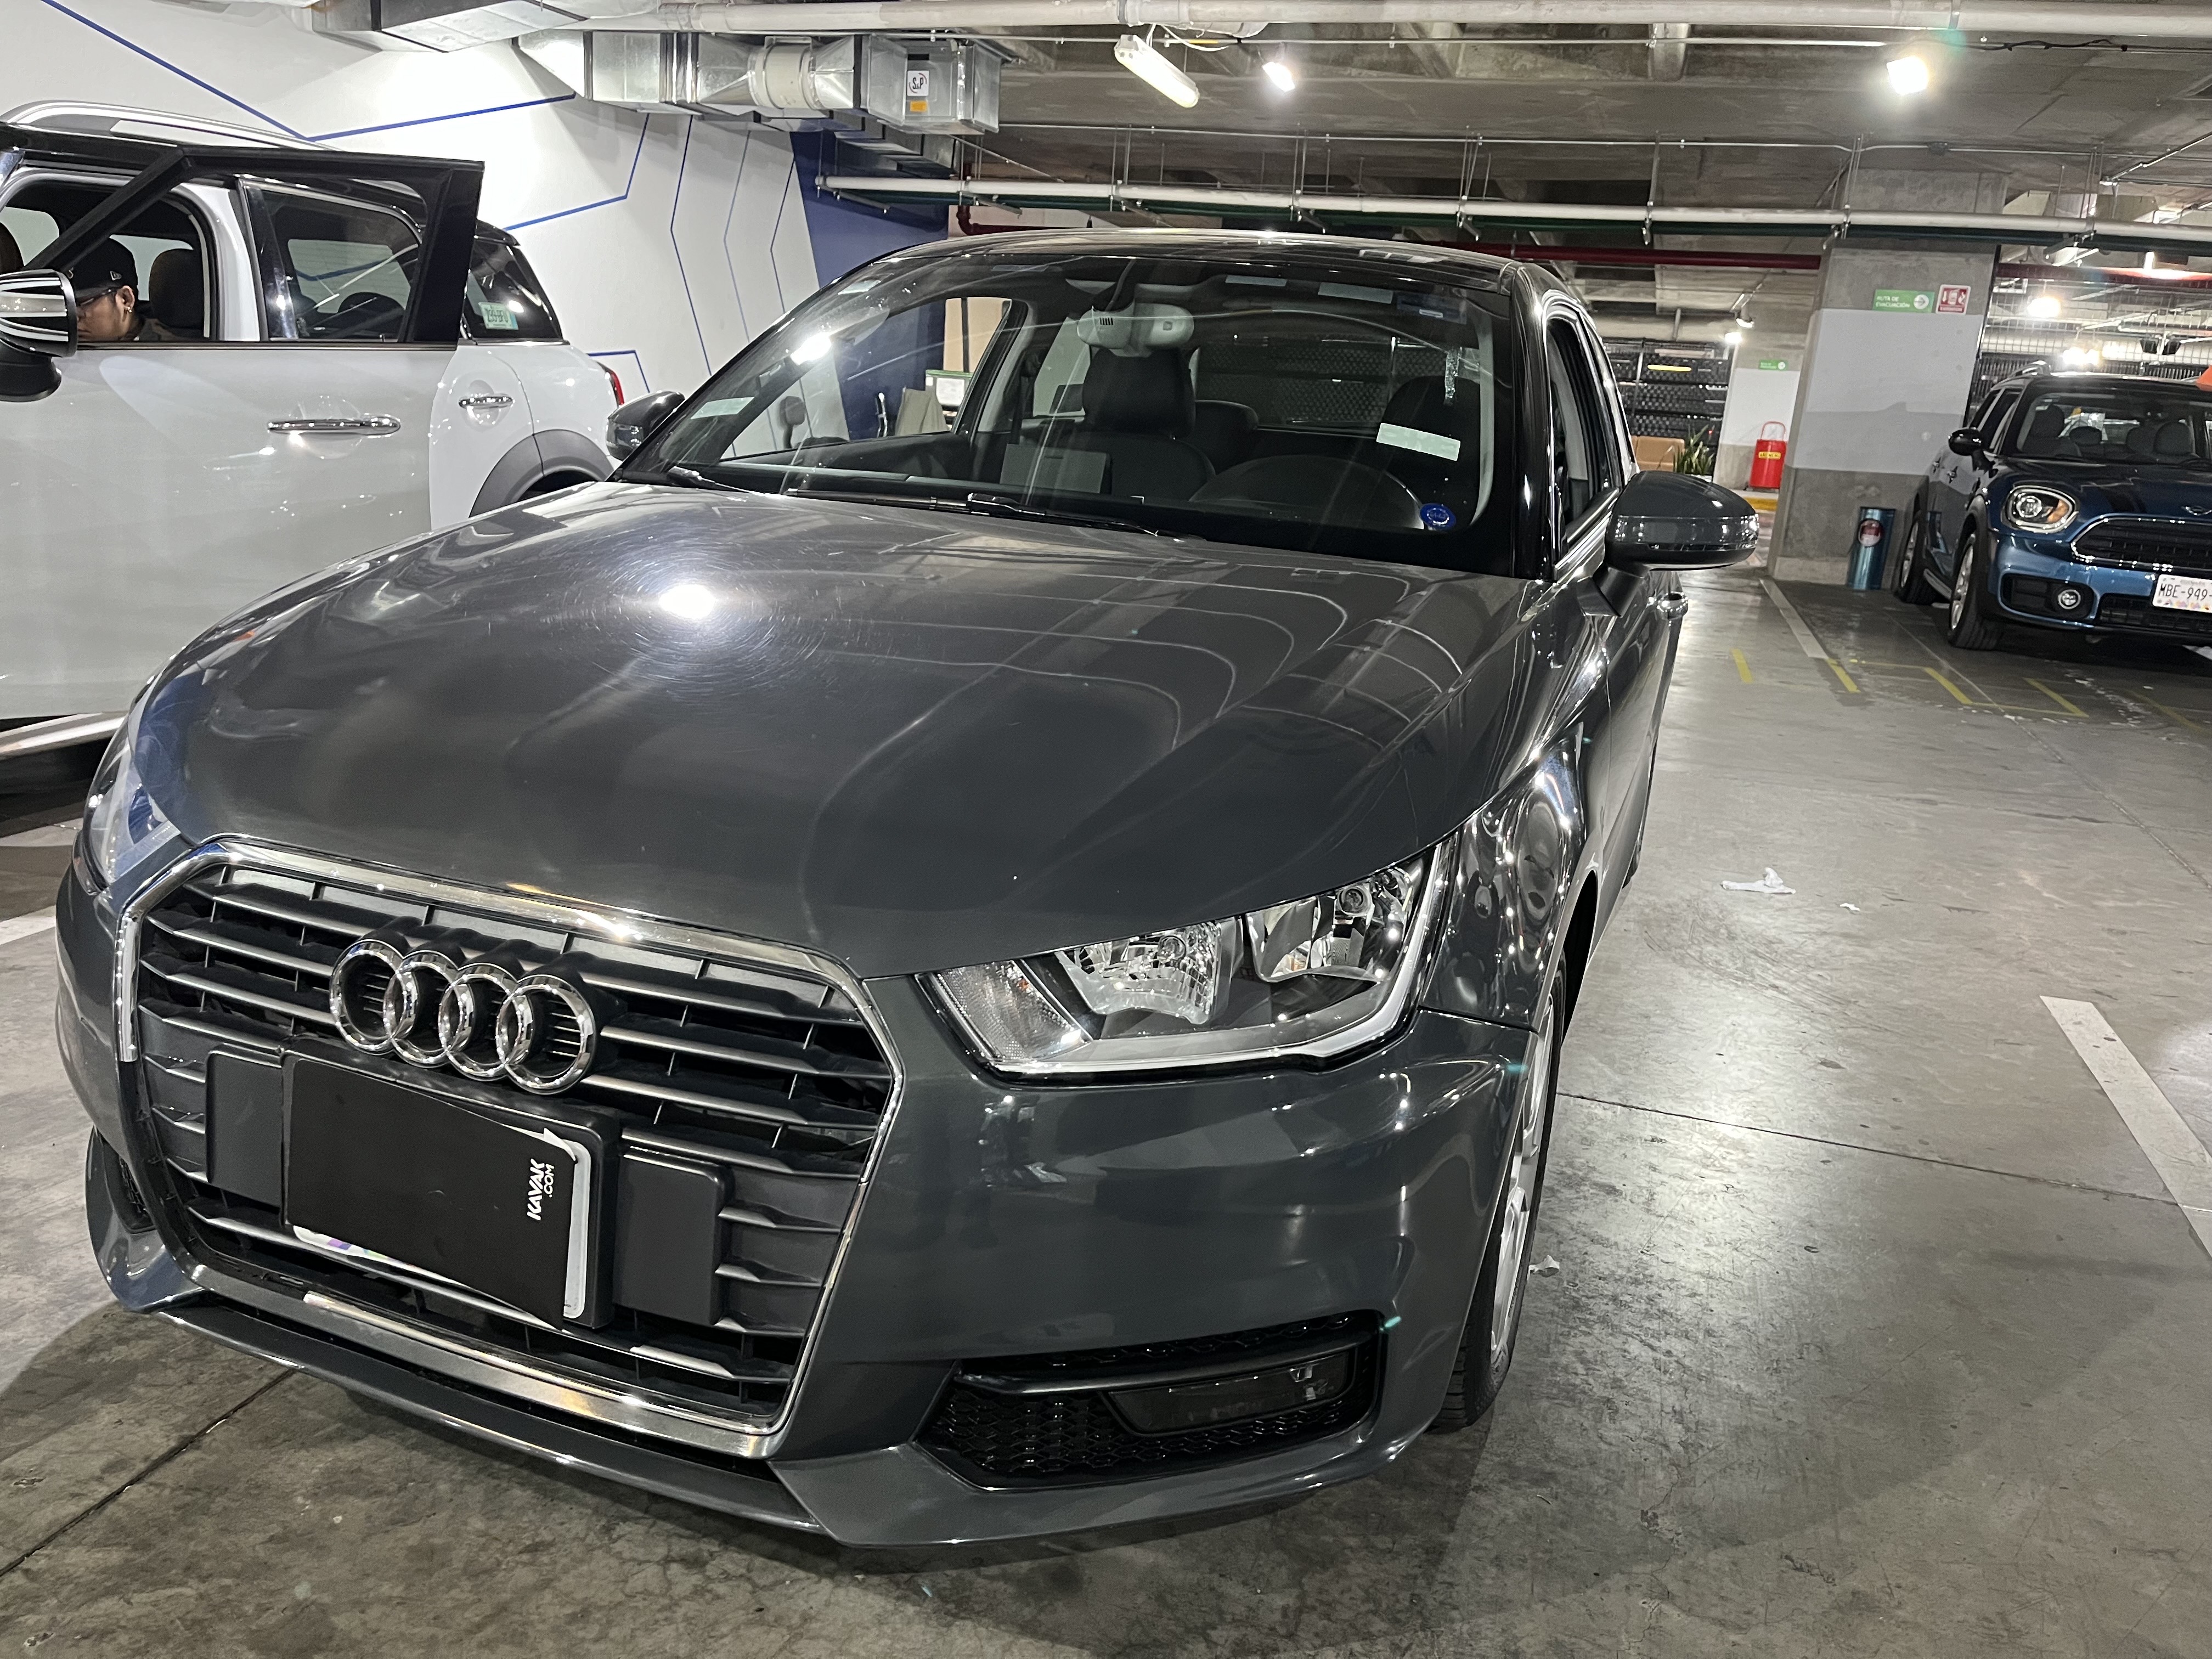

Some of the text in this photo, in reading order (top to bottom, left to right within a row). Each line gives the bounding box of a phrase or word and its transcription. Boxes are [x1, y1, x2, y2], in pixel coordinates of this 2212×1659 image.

[912, 77, 924, 89] S&P
[527, 1158, 545, 1221] KAVAK
[544, 1164, 555, 1198] .COM
